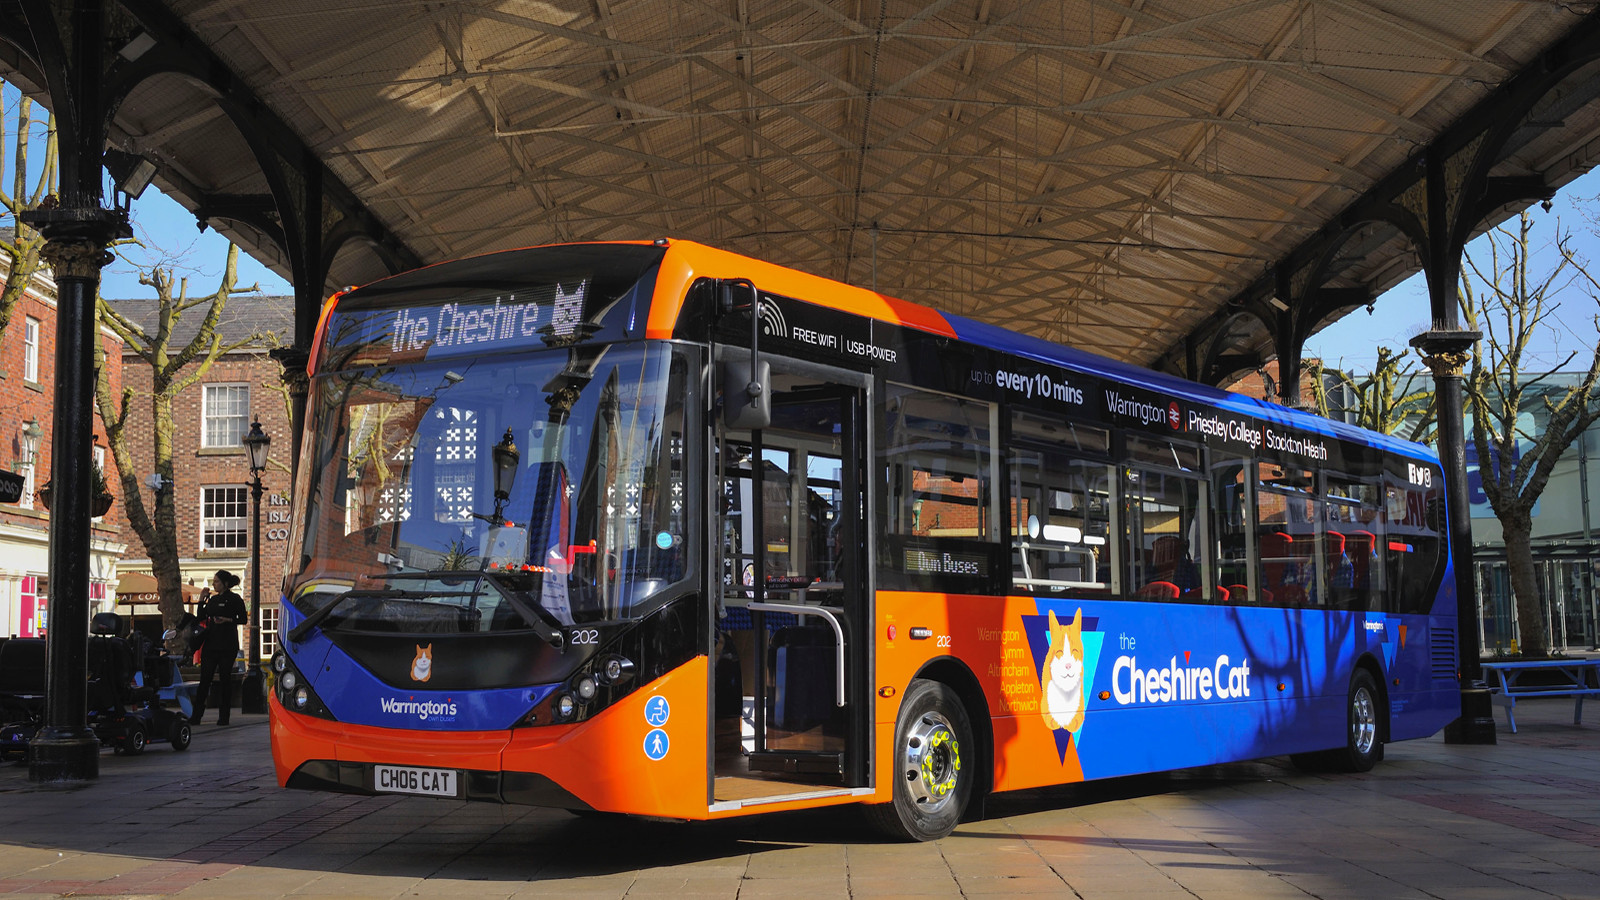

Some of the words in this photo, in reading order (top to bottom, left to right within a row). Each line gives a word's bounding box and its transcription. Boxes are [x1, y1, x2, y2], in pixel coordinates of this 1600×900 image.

[392, 309, 429, 353] the
[436, 295, 539, 347] Cheshire
[793, 326, 817, 344] FREE
[817, 333, 837, 349] WIFI
[846, 340, 865, 355] USB
[866, 344, 897, 363] POWER
[970, 369, 983, 385] up
[984, 370, 993, 385] to
[996, 370, 1034, 399] every
[1035, 373, 1051, 398] 10
[1053, 380, 1084, 405] mins
[1105, 389, 1167, 426] Warrington
[1189, 410, 1229, 442] Priestley
[1229, 419, 1262, 449] College
[1266, 429, 1303, 455] Stockton
[1303, 438, 1328, 461] Heath
[943, 552, 979, 574] Buses
[571, 629, 599, 645] 202
[936, 635, 952, 648] 202
[977, 627, 1020, 645] Warrington
[1119, 631, 1136, 650] the
[1000, 645, 1025, 662] Lymm
[987, 661, 1030, 677] Altrincham
[1112, 651, 1213, 705] Cheshire
[1214, 654, 1250, 699] Cat
[1000, 680, 1035, 697] Appleton
[381, 695, 457, 720] Warrington's
[999, 696, 1039, 712] Northwich
[380, 768, 418, 790] CH06
[421, 771, 450, 792] CAT
